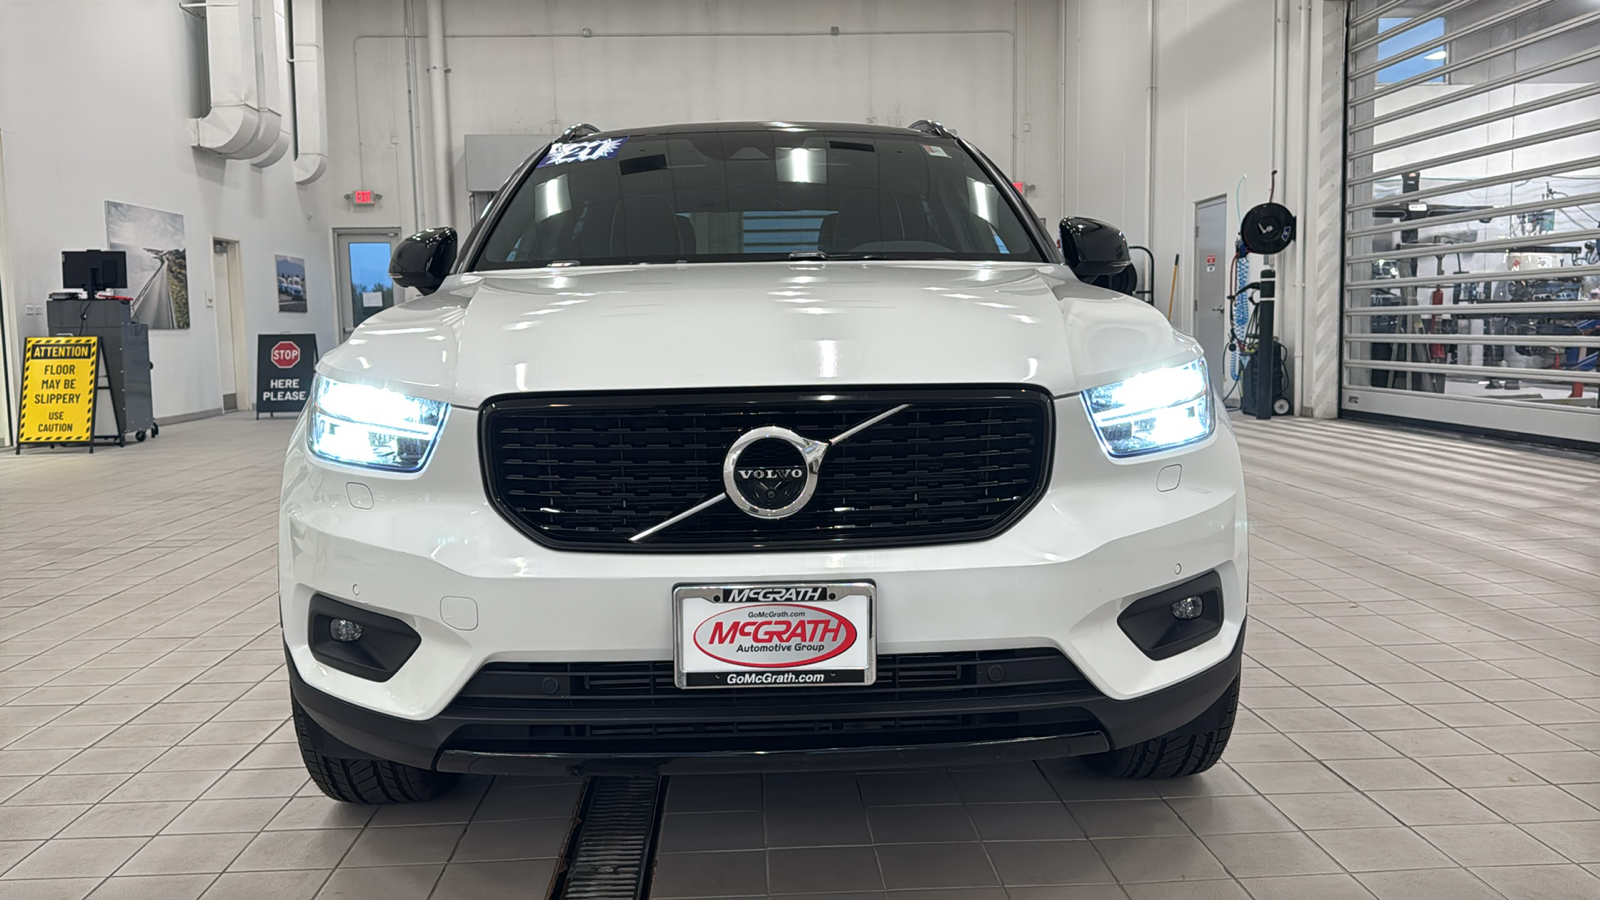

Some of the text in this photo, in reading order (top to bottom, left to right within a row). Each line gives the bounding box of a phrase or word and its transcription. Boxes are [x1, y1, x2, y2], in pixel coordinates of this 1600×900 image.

[561, 143, 604, 159] 21
[355, 190, 372, 203] EXIT
[33, 345, 89, 358] ATTENTION
[273, 349, 299, 360] STOP
[44, 364, 76, 375] FLOOR
[41, 379, 77, 390] MAY BE
[270, 378, 300, 389] HERE
[34, 393, 81, 405] SLIPPERY
[263, 391, 307, 401] PLEASE
[48, 411, 65, 421] USE
[38, 423, 73, 433] CAUTION
[738, 468, 803, 479] VOLVO
[747, 610, 806, 619] GoMcGrath.com
[736, 642, 825, 653] Automotive Group
[726, 672, 825, 685] GoMcGrath.com
